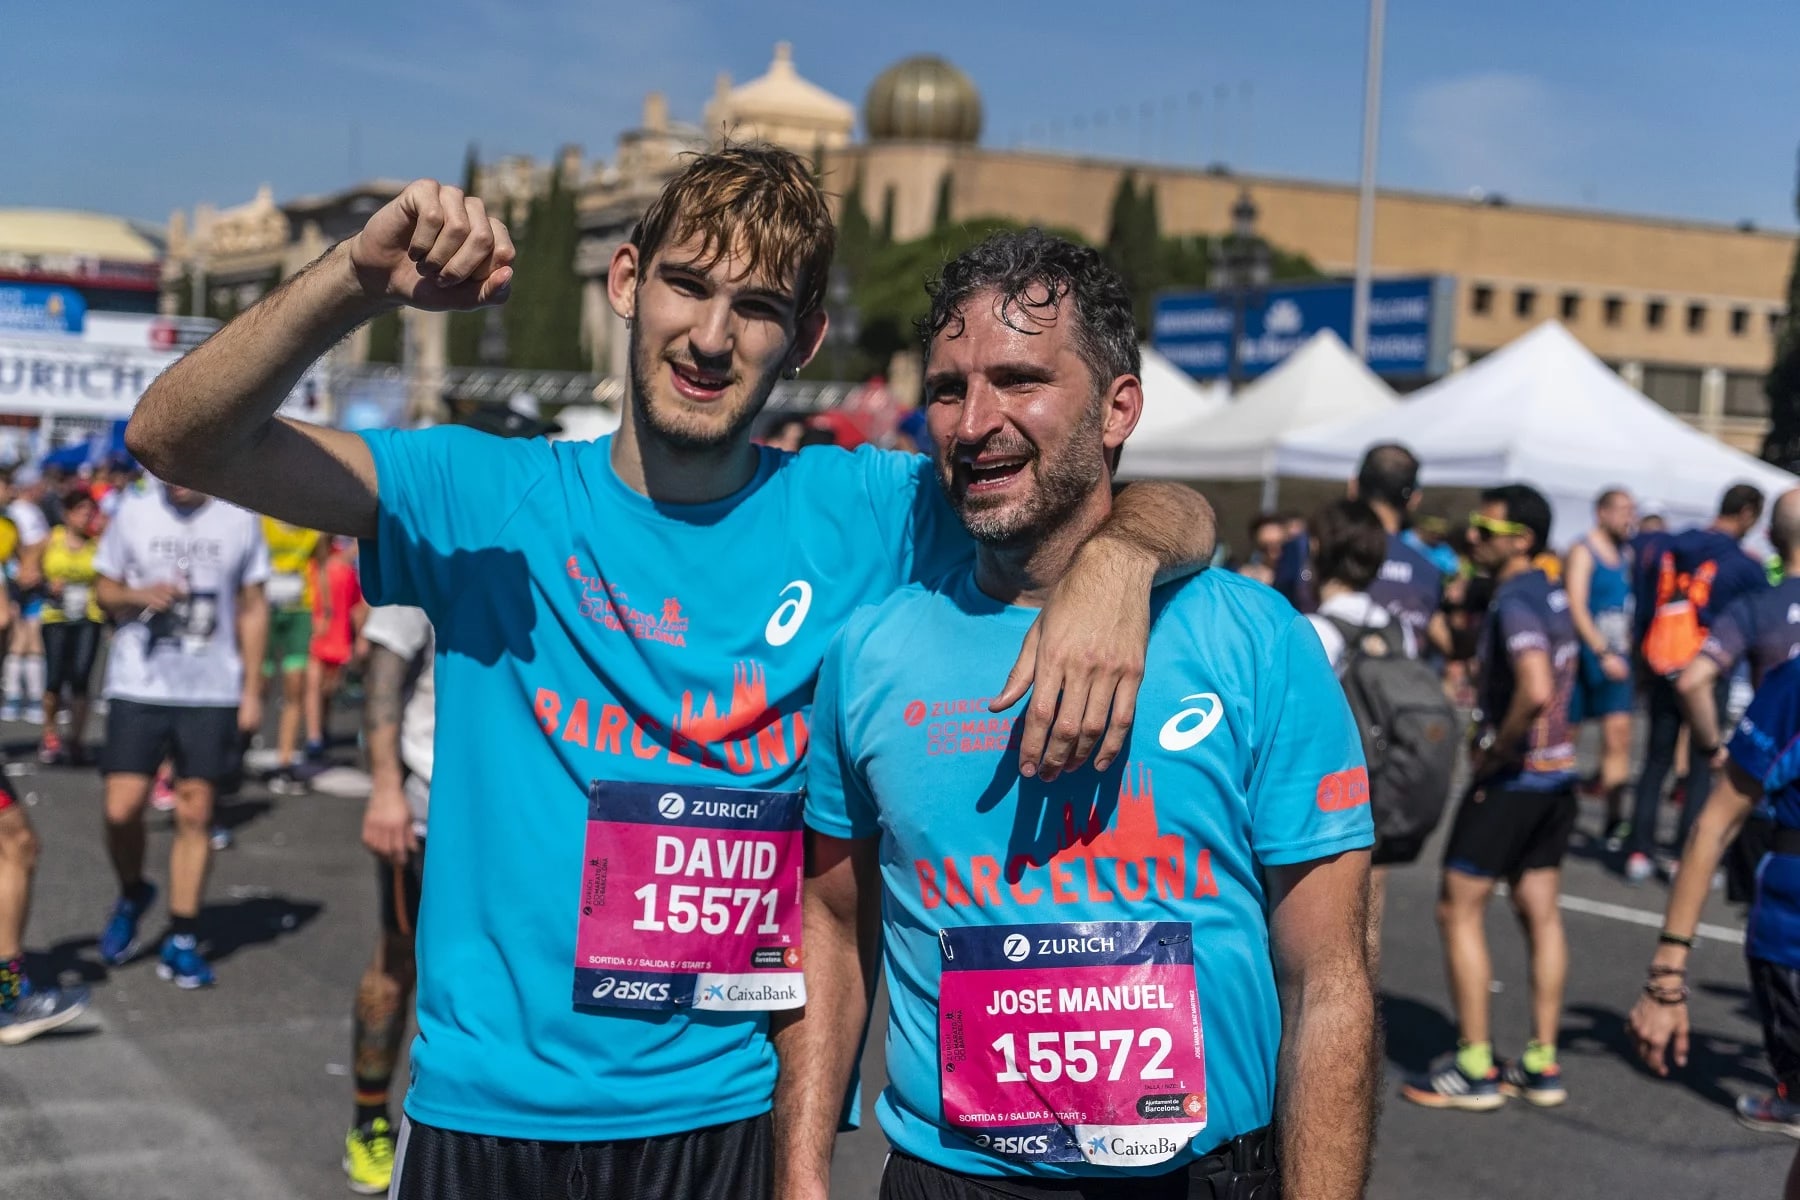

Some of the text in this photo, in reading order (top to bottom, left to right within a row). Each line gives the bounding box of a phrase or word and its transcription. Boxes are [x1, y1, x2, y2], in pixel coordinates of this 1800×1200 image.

[690, 801, 758, 819] ZURICH
[655, 835, 777, 880] DAVID
[914, 836, 1219, 910] BARCELONA
[632, 883, 780, 935] 15571
[1038, 937, 1115, 955] ZURICH
[589, 955, 625, 966] SORTIDA
[639, 958, 669, 968] SALIDA
[671, 961, 675, 969] 5
[681, 961, 706, 970] START
[706, 962, 712, 970] 5
[726, 985, 798, 1002] CaixaBank
[986, 984, 1174, 1015] JOSE MANUEL
[991, 1027, 1174, 1083] 15572
[959, 1113, 996, 1122] SORTIDA
[1010, 1111, 1040, 1121] SALIDA
[1043, 1110, 1049, 1118] 5
[1081, 1112, 1087, 1120] 5
